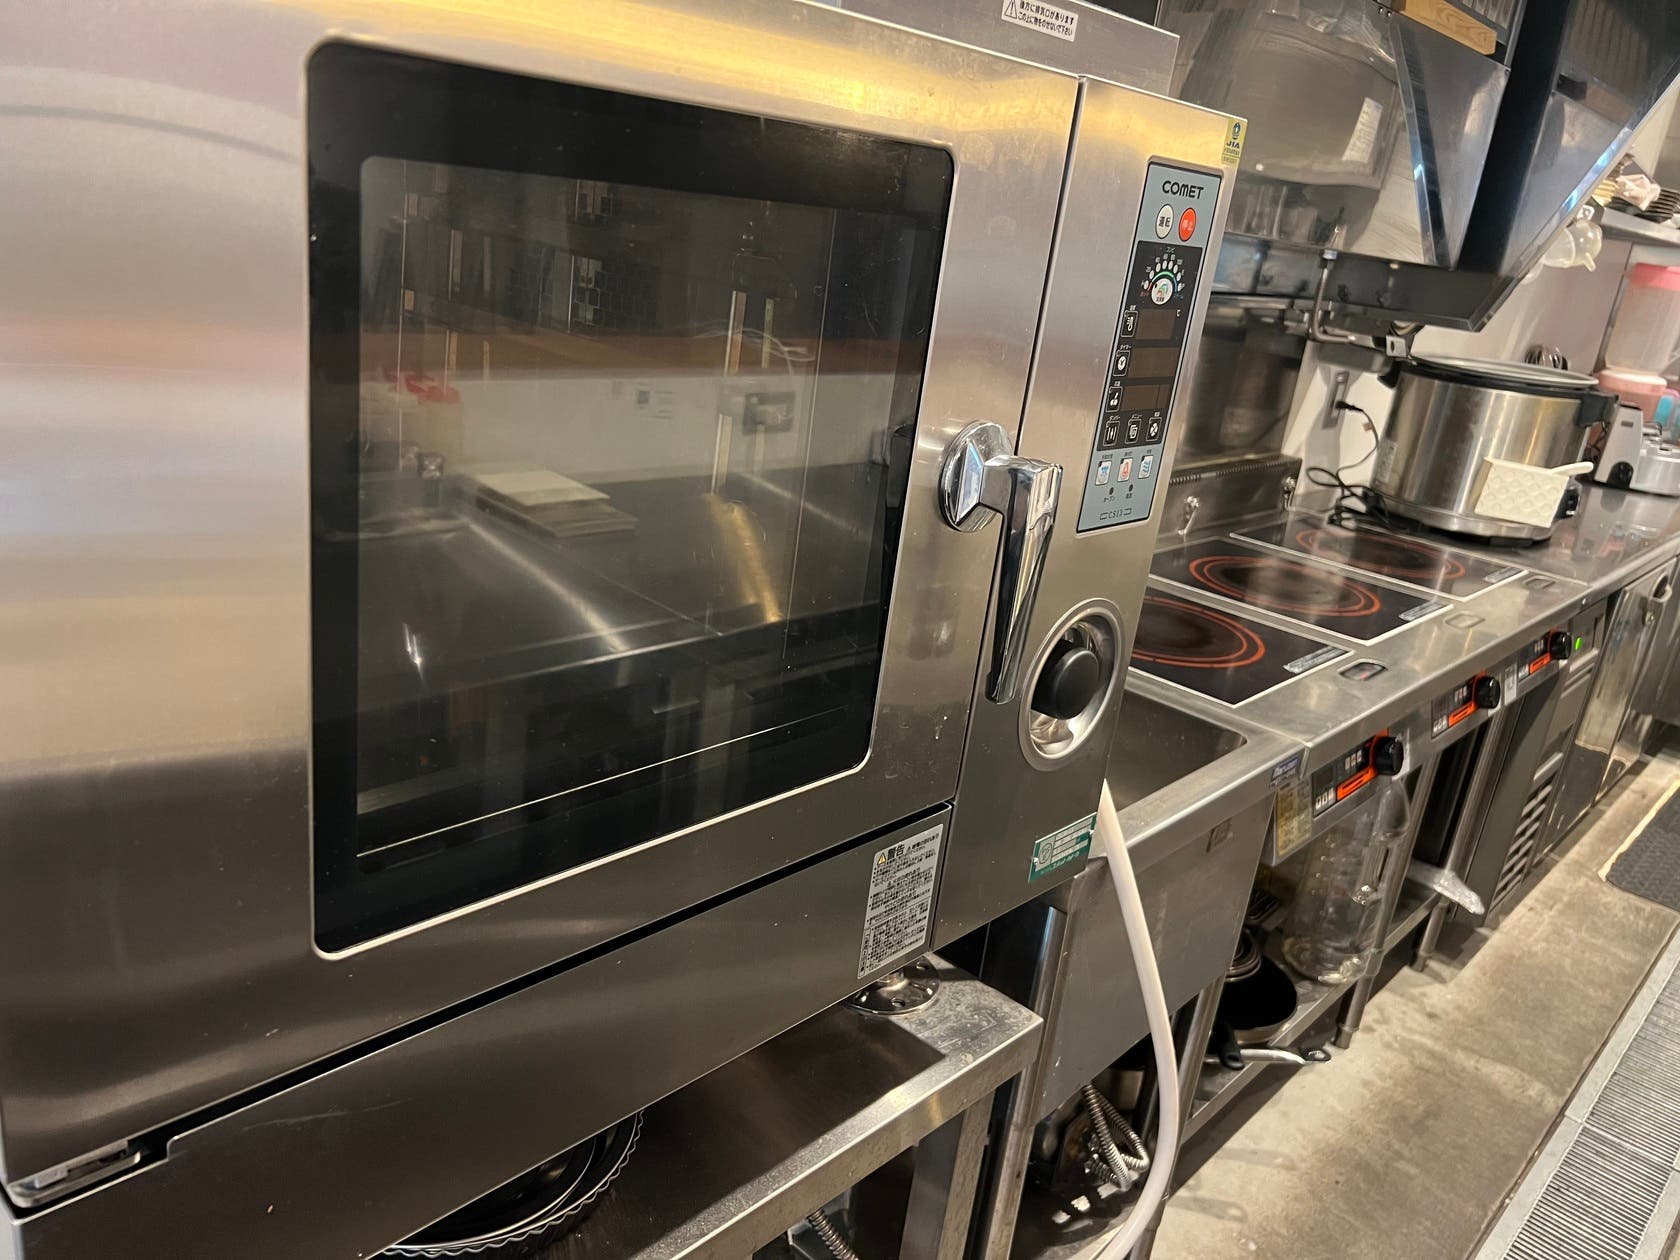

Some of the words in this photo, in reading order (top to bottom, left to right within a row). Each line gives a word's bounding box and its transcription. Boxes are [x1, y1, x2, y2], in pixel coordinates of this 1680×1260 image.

[1226, 141, 1240, 149] JIA
[1162, 180, 1204, 199] COMET
[888, 843, 905, 860] 警告
